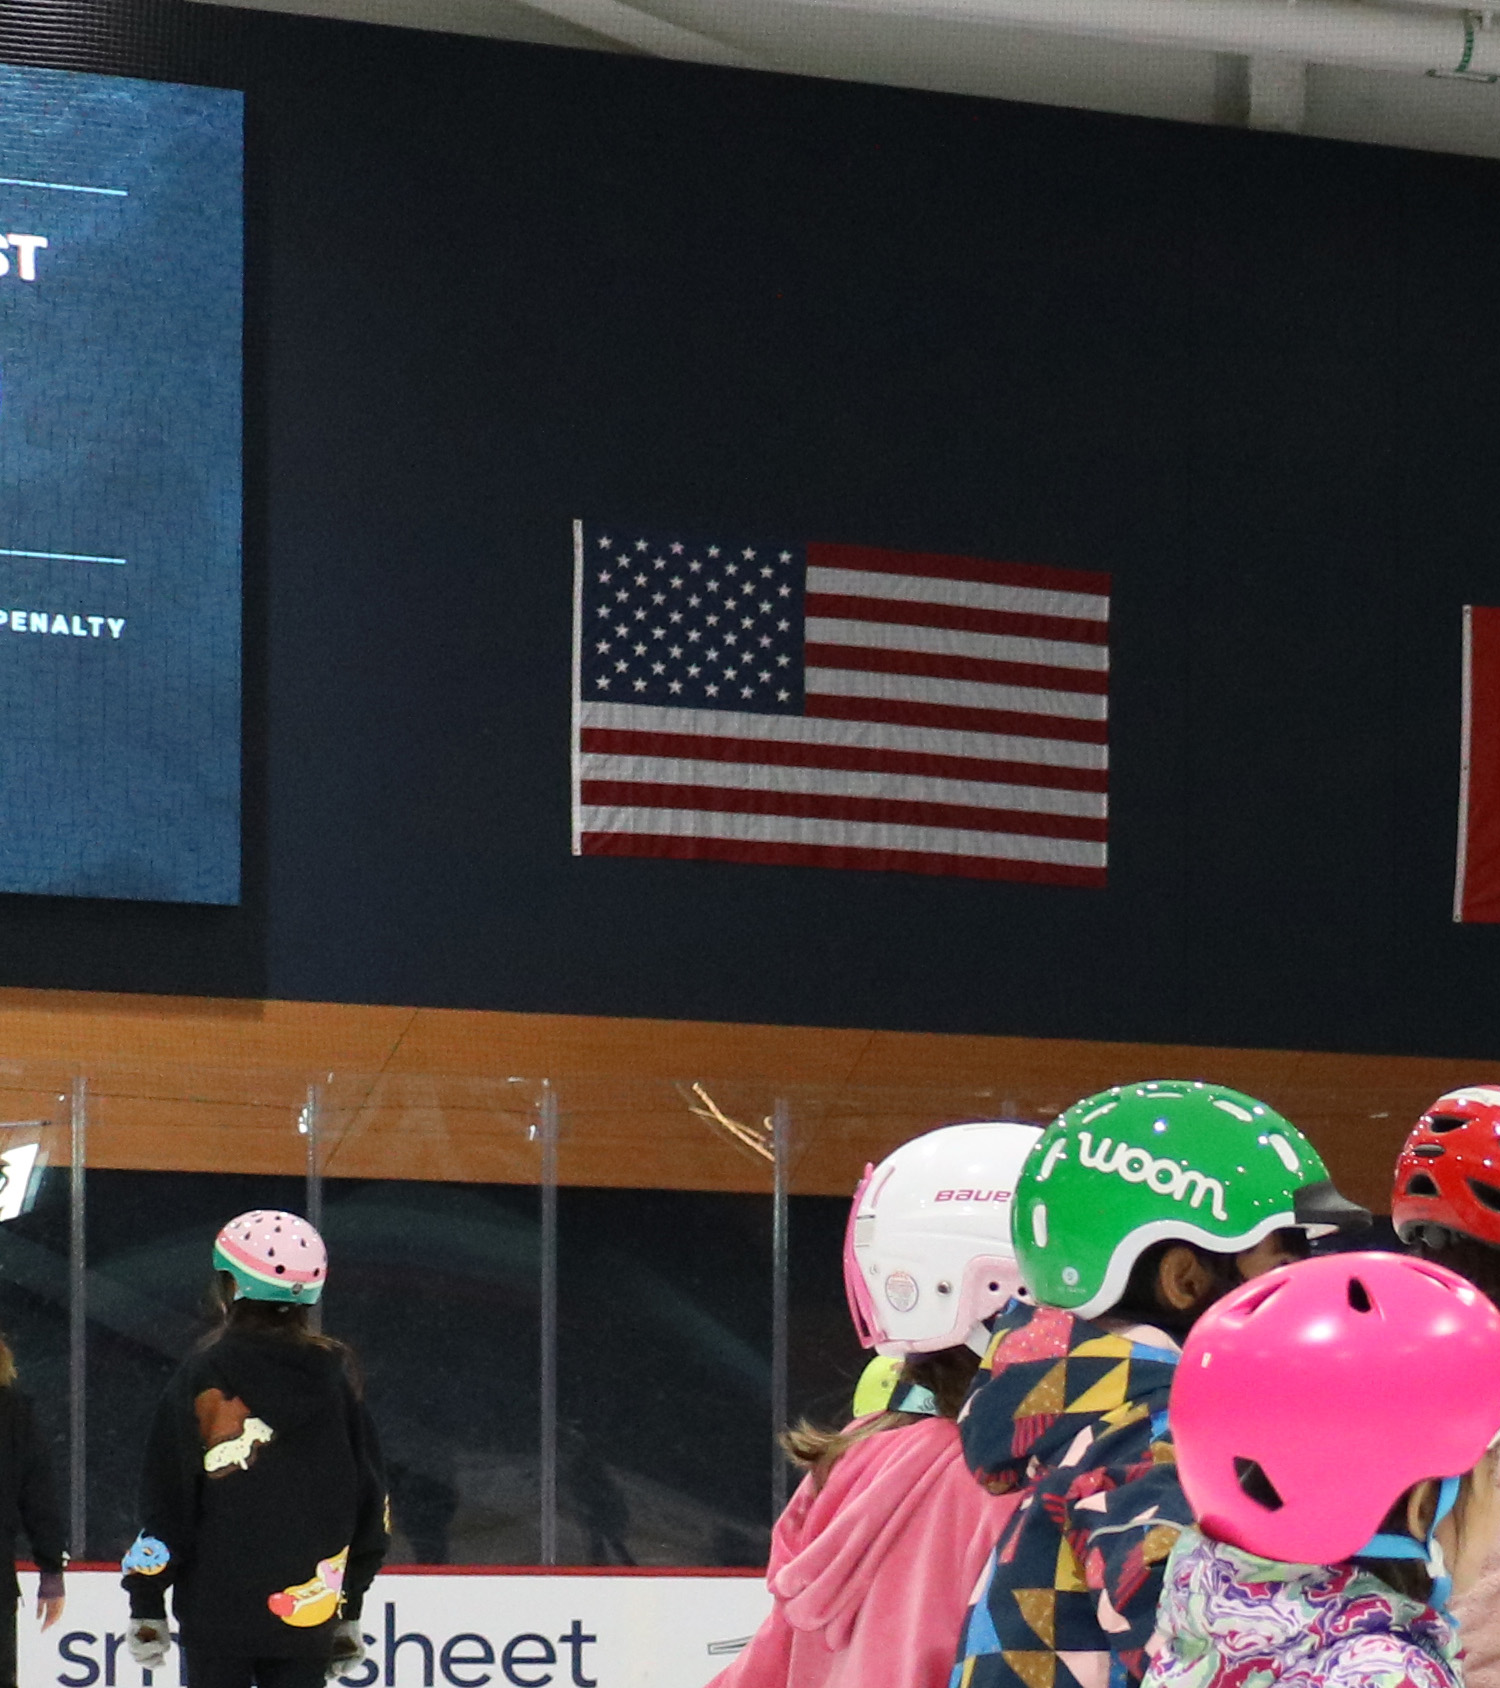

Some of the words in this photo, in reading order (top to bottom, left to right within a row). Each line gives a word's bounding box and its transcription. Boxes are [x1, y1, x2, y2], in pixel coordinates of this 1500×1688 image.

[0, 232, 48, 281] T
[934, 1189, 1012, 1203] BAUE
[1078, 1131, 1228, 1221] woom
[57, 1602, 597, 1688] smsheet
